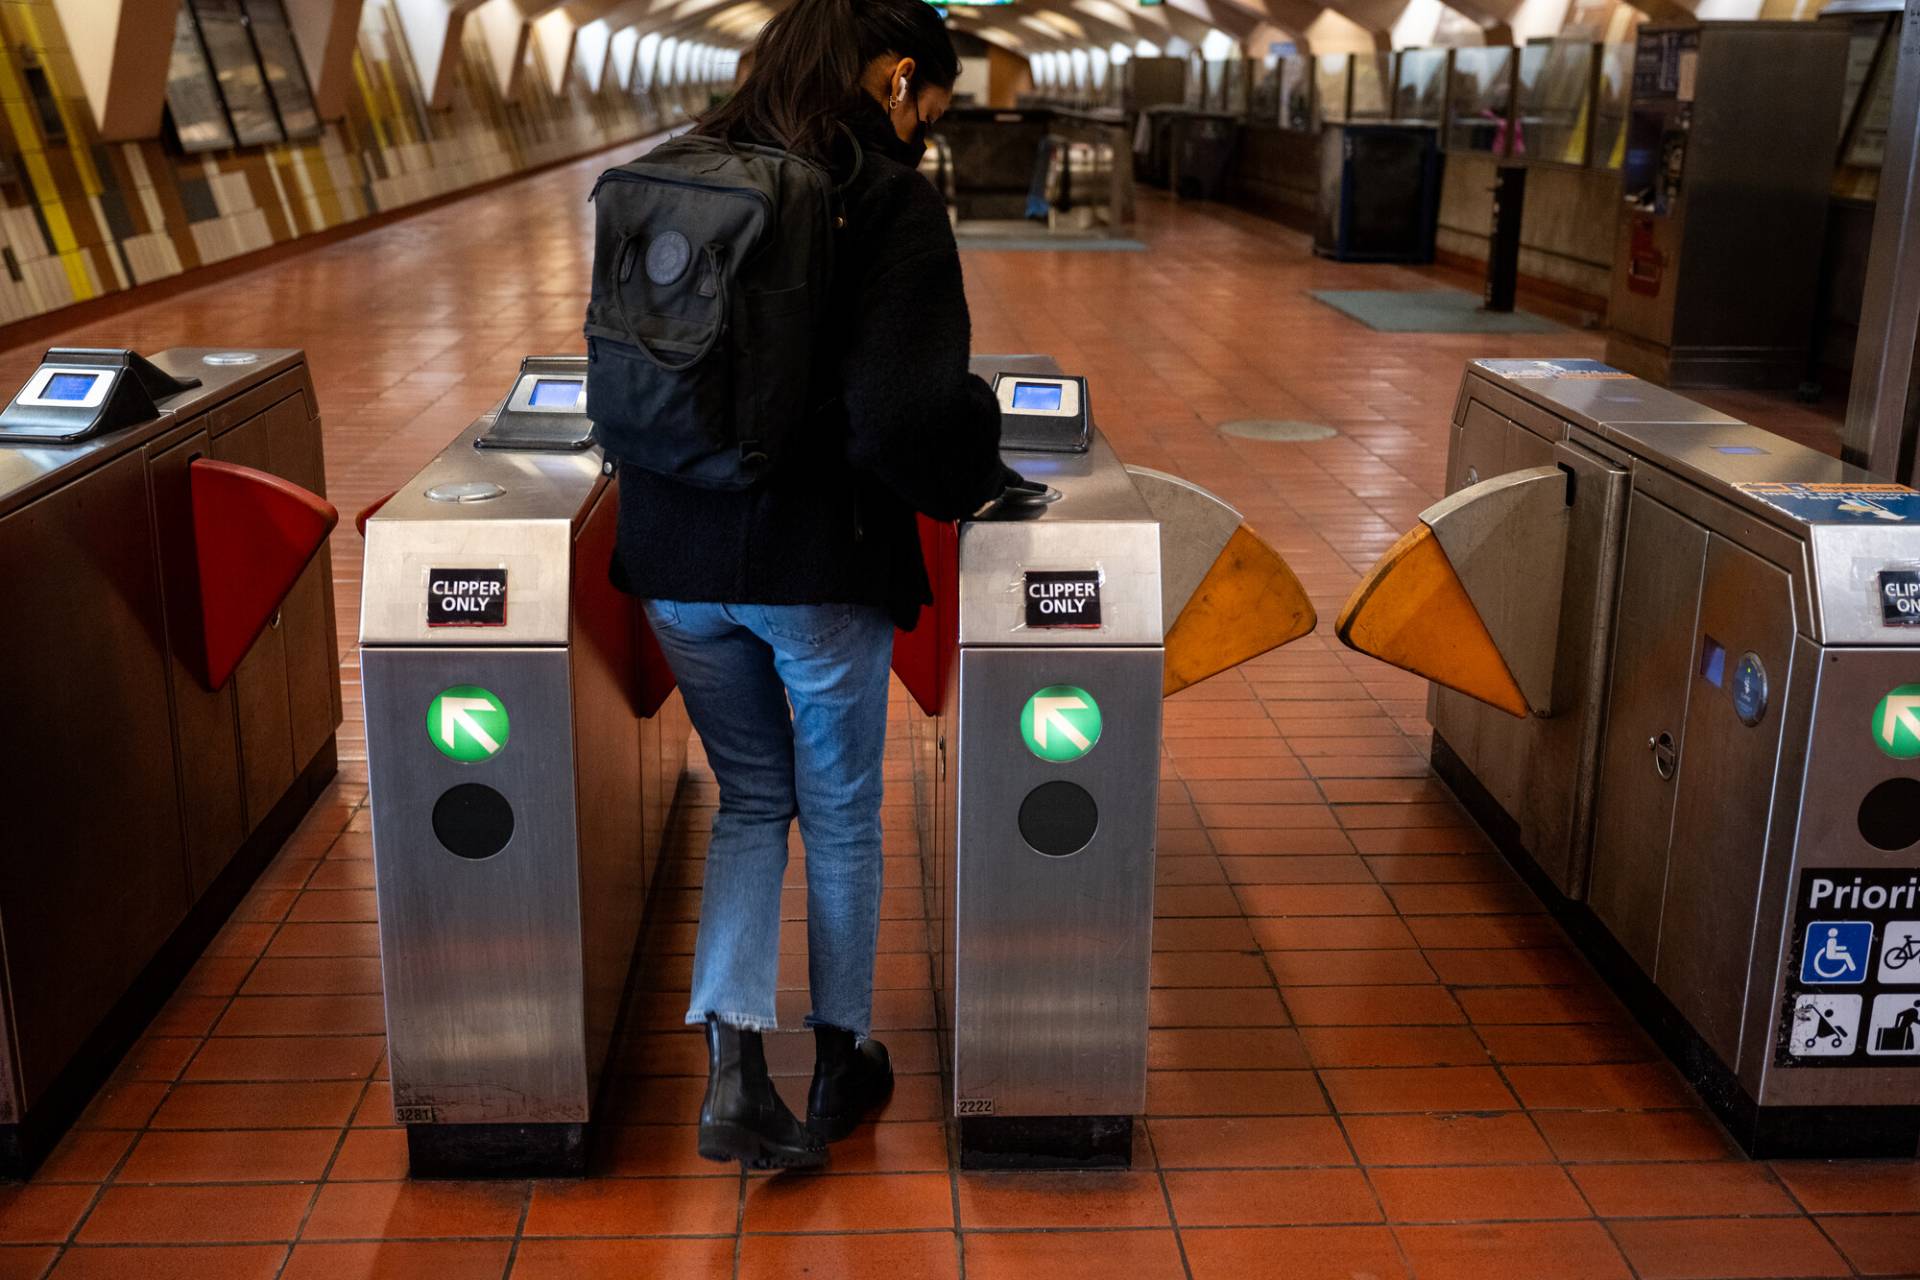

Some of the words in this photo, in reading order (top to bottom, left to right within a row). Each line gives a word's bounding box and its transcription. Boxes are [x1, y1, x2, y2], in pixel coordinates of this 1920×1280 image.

[432, 580, 501, 595] CLIPPER
[1028, 582, 1096, 598] CLIPPER
[1885, 583, 1920, 597] CLIP
[441, 597, 490, 612] ONLY
[1039, 598, 1086, 614] ONLY
[1809, 877, 1920, 909] Priori
[959, 1100, 992, 1113] 2222
[396, 1109, 429, 1121] 3281
